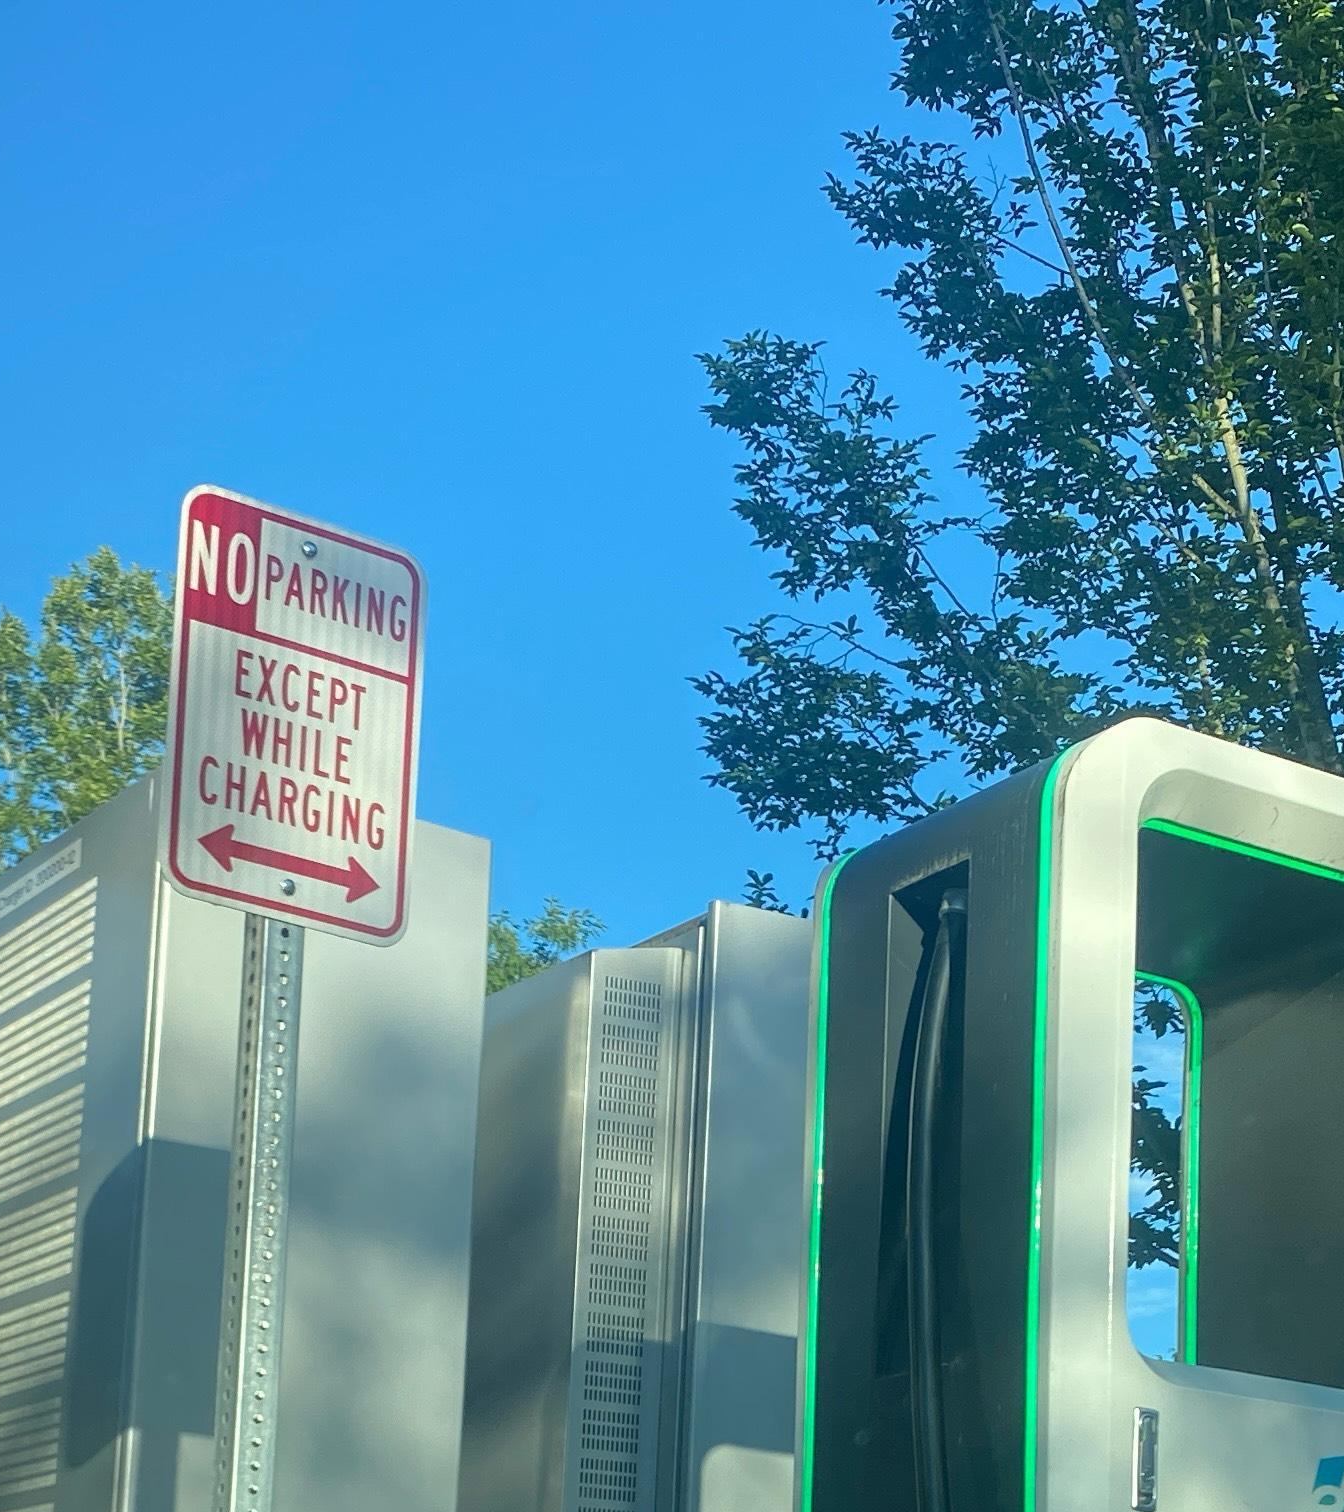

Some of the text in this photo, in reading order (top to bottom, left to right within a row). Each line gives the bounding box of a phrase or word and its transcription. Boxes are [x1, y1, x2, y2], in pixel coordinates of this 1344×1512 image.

[188, 518, 408, 643] NO PARKING
[234, 649, 367, 731] EXCEPT
[240, 708, 352, 785] WHILE
[199, 755, 385, 851] CHARGING
